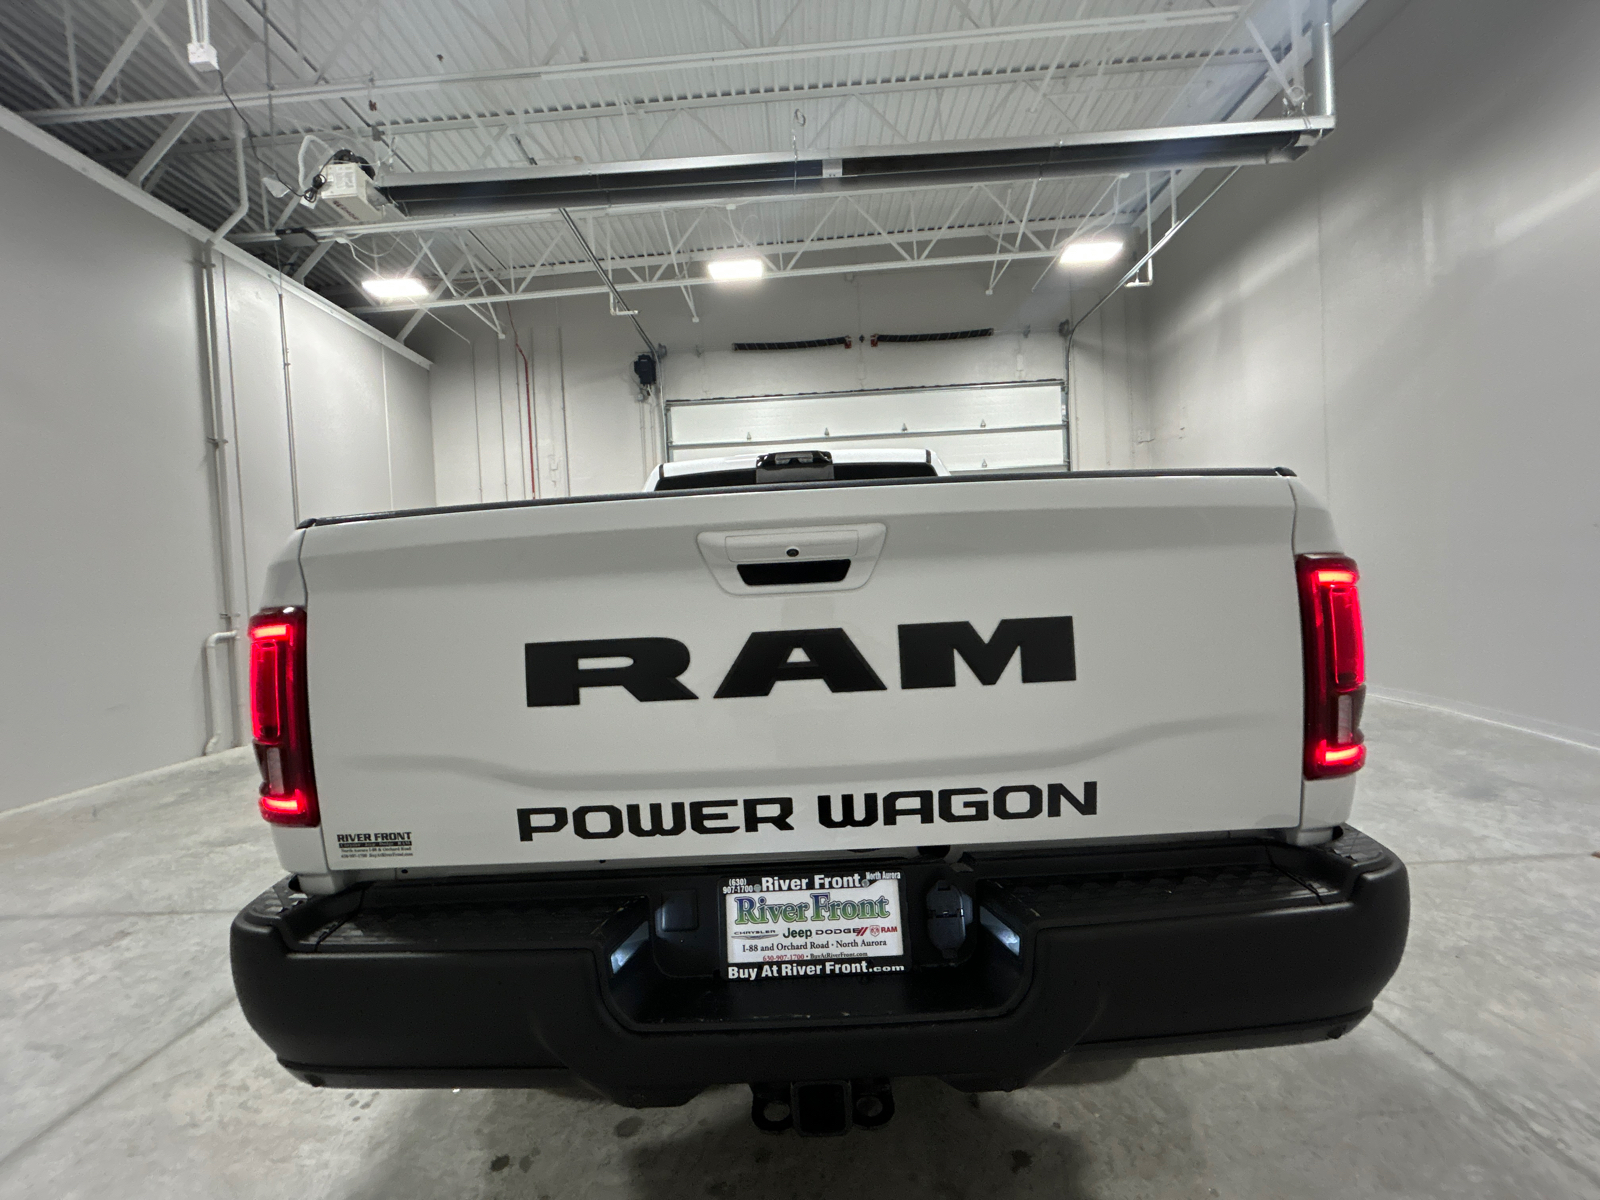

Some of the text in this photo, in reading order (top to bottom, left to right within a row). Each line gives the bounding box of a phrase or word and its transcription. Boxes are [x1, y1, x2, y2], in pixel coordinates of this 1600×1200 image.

[525, 616, 1077, 707] RAM
[517, 781, 1098, 842] POWER WAGON
[336, 832, 412, 842] RIVER FRONT
[866, 871, 900, 880] North Aurora
[729, 878, 747, 886] (630)
[761, 873, 860, 892] River Front
[722, 885, 754, 894] 907-1700
[783, 928, 812, 940] Jeep
[816, 928, 860, 936] DODGE
[742, 939, 887, 952] I-88 and Orchard Road North Aurora
[728, 961, 904, 980] Buy At River Front.com
